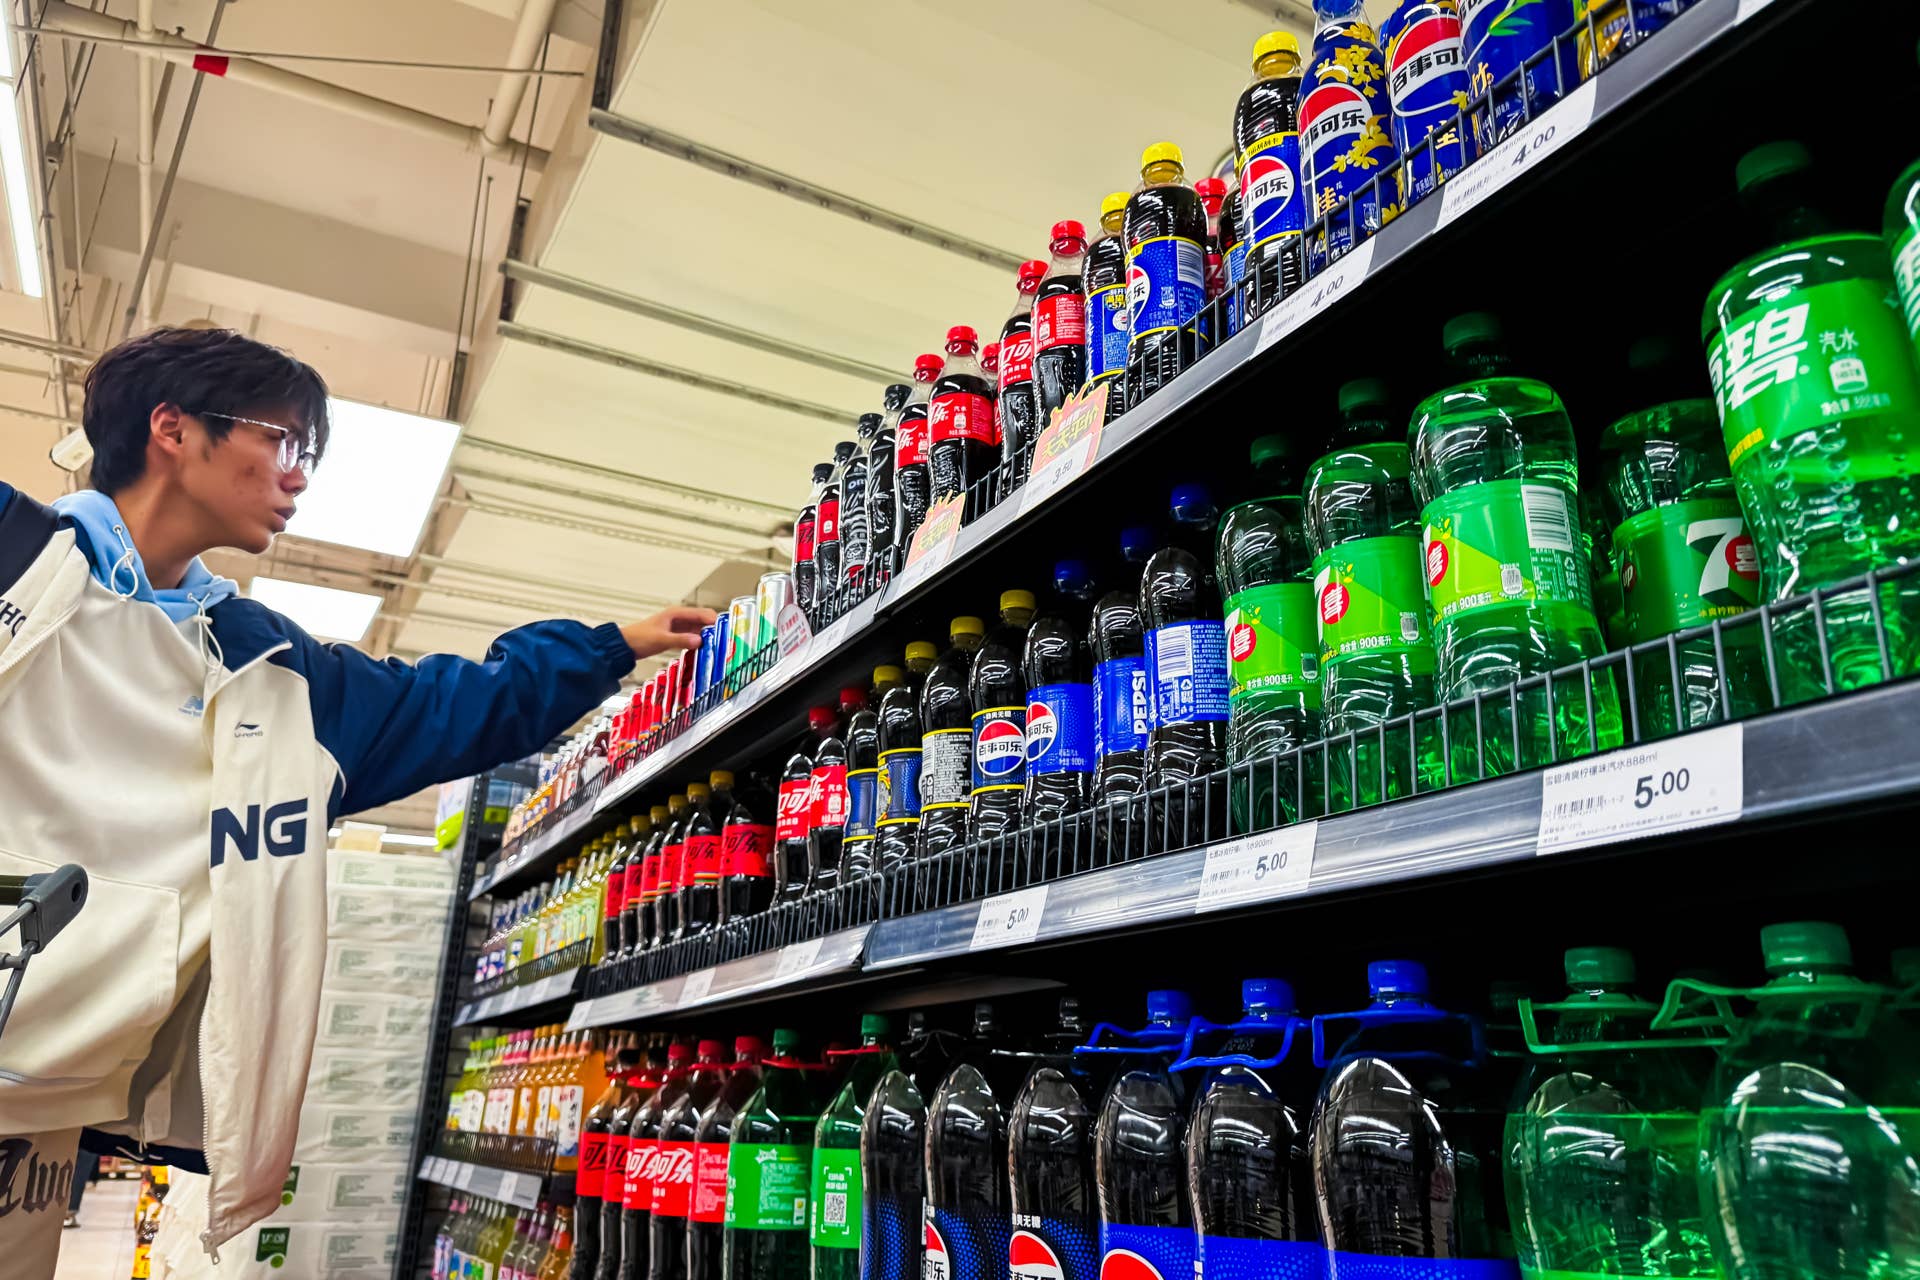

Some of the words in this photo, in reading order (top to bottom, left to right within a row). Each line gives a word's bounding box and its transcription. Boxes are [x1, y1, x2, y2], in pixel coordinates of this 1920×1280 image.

[1393, 47, 1465, 97] 百事可
[1511, 126, 1556, 167] 4.00
[1310, 275, 1344, 308] 4.00
[1819, 329, 1859, 354] 汽水
[1132, 670, 1148, 734] PEPSI
[979, 741, 1022, 756] 百事可乐
[1634, 767, 1690, 809] 5.00
[211, 797, 308, 869] NG
[1254, 850, 1288, 880] 5.00
[1007, 907, 1029, 930] 5.00
